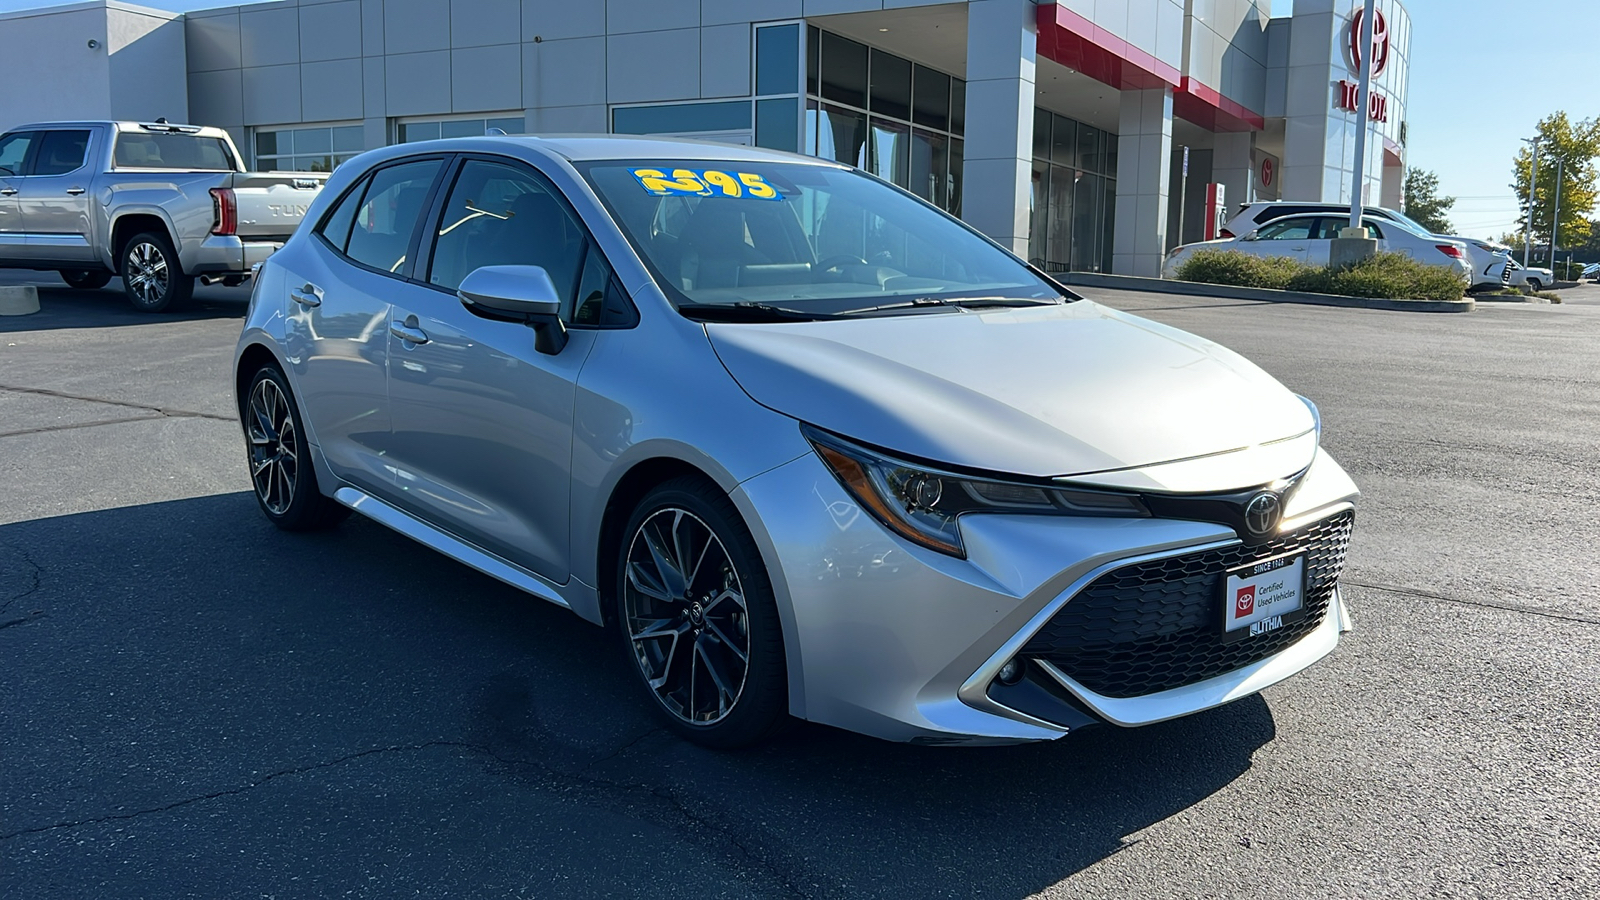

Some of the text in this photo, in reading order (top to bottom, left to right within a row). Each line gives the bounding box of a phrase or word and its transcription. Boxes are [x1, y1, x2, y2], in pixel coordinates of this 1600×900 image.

[1341, 81, 1387, 121] TOOTA
[1253, 562, 1272, 574] SINCE
[1259, 580, 1284, 595] Certified
[1257, 589, 1296, 608] Used Vehicles
[1256, 615, 1283, 634] LITHIA
